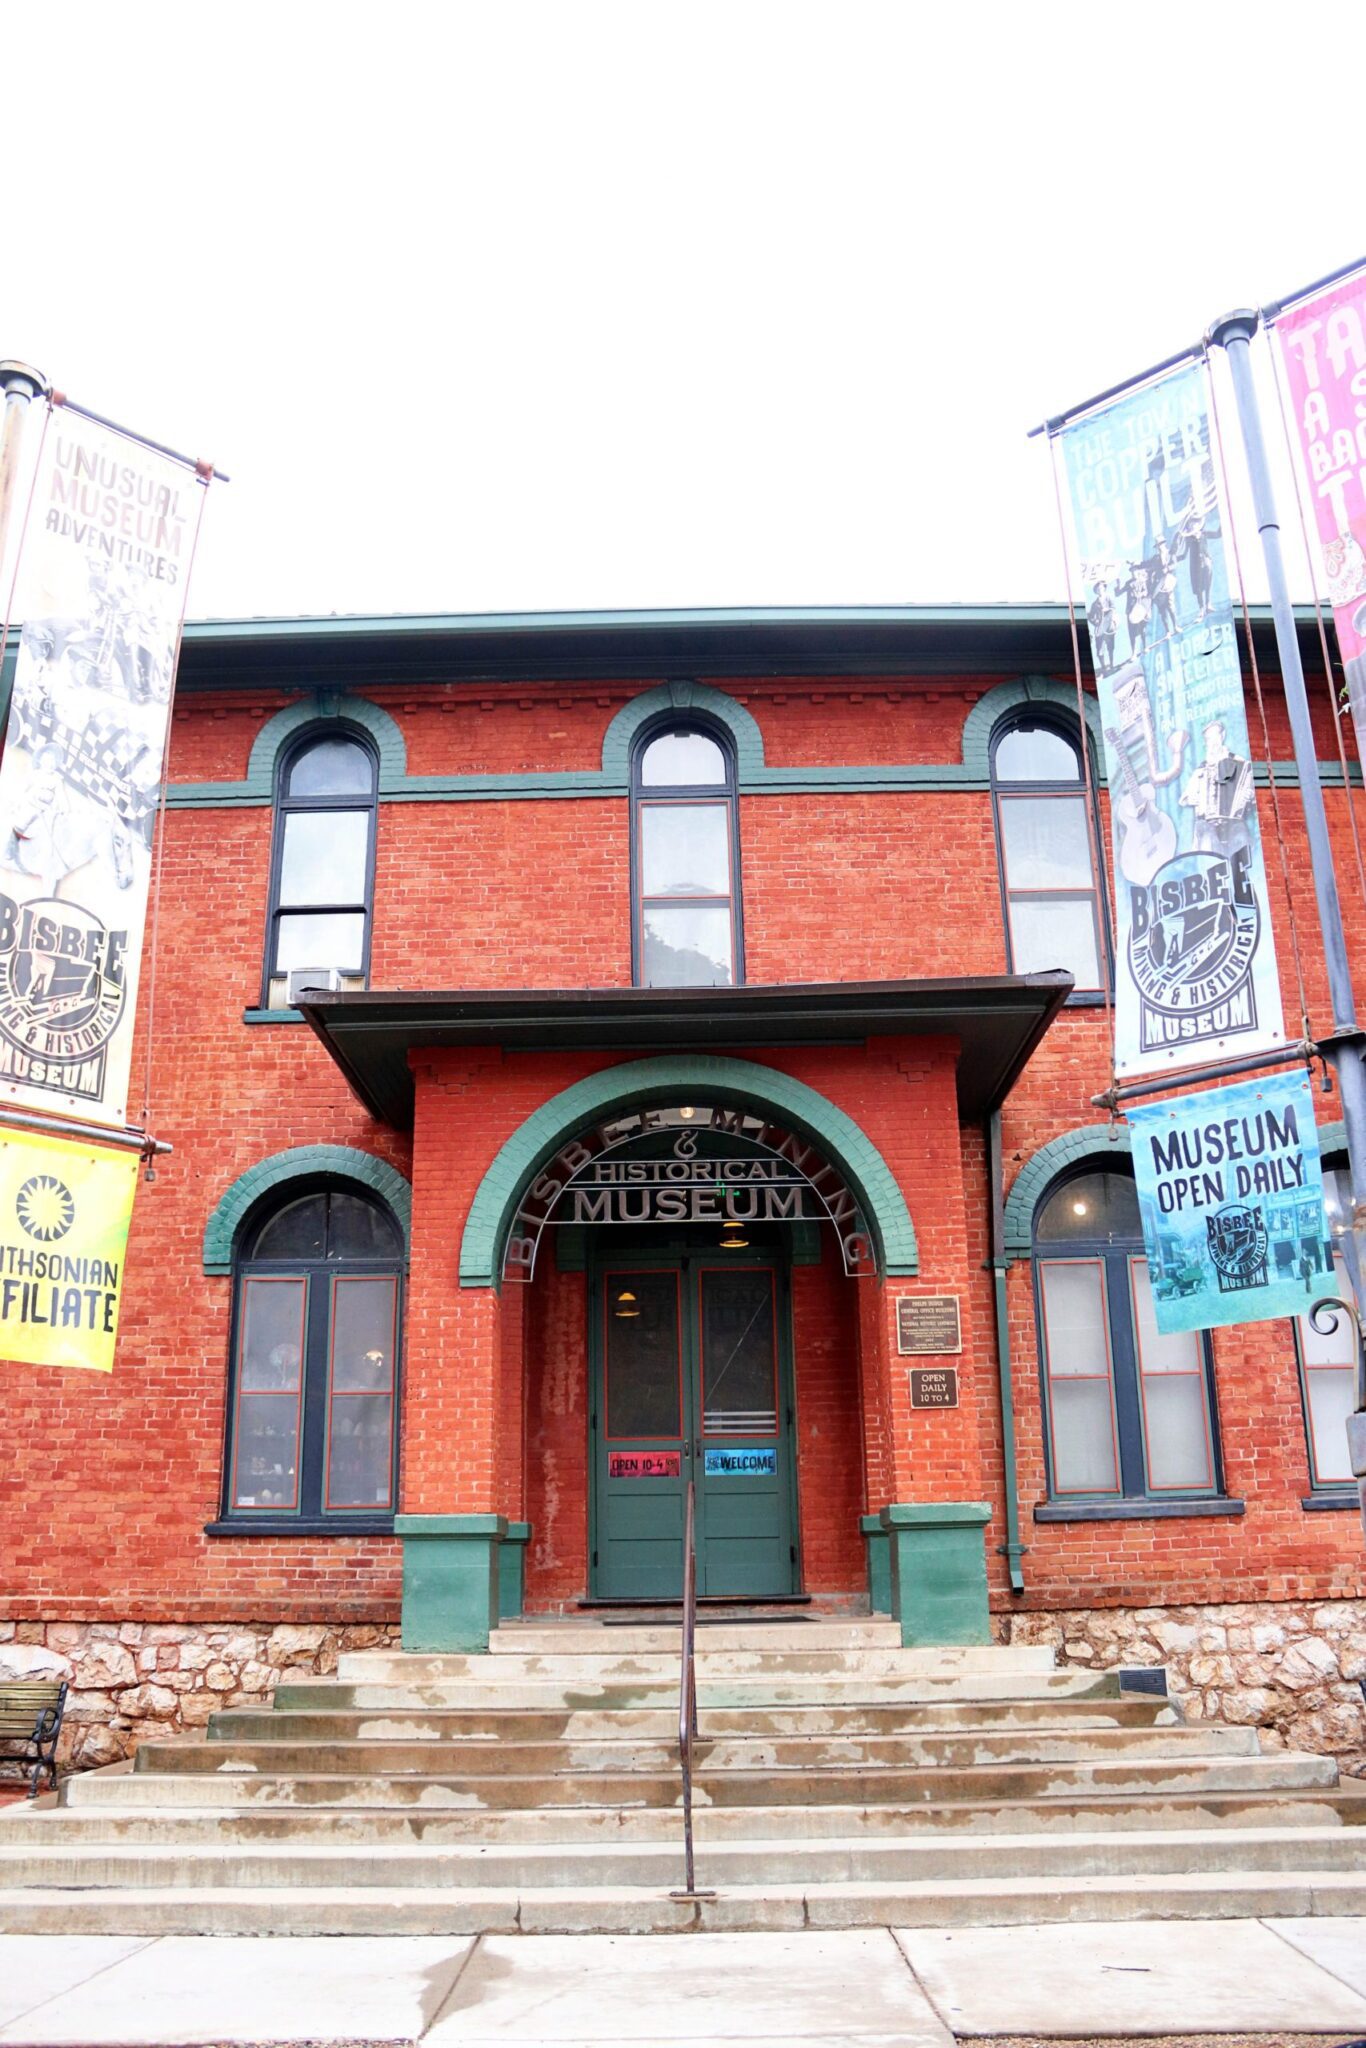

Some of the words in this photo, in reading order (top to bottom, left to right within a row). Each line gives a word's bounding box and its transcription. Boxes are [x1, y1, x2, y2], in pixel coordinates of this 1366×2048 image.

[55, 436, 187, 523] UNUSUAL
[1073, 429, 1115, 471] THE
[1076, 413, 1209, 510] COPPER
[50, 467, 182, 557] MUSEUM
[1083, 452, 1213, 560] BUILT
[45, 507, 178, 586] ADVENTURES
[1130, 845, 1254, 941] BISBEE
[0, 892, 128, 986] BISBEE
[1133, 946, 1166, 1001] MINING
[1171, 987, 1181, 1005] &
[25, 1026, 37, 1044] &
[45, 993, 120, 1053] HISTORICAL
[1145, 985, 1251, 1045] MUSEUM
[673, 1130, 699, 1159] &
[1150, 1104, 1300, 1176] MUSEUM
[507, 1110, 669, 1267] BISBEE
[709, 1106, 871, 1267] MINING
[594, 1160, 790, 1182] HISTORICAL
[1157, 1170, 1225, 1214] OPEN
[1235, 1153, 1303, 1199] DAILY
[574, 1188, 804, 1222] MUSEUM
[1205, 1205, 1264, 1241] BISBEE
[1220, 1267, 1265, 1289] MUSEUM
[920, 1394, 929, 1402] 10
[931, 1394, 942, 1402] TO
[944, 1394, 949, 1402] 4
[921, 1374, 946, 1382] OPEN
[921, 1384, 947, 1392] DAILY
[611, 1460, 638, 1470] OPEN
[642, 1460, 663, 1470] 10-4
[719, 1456, 774, 1470] WELCOME
